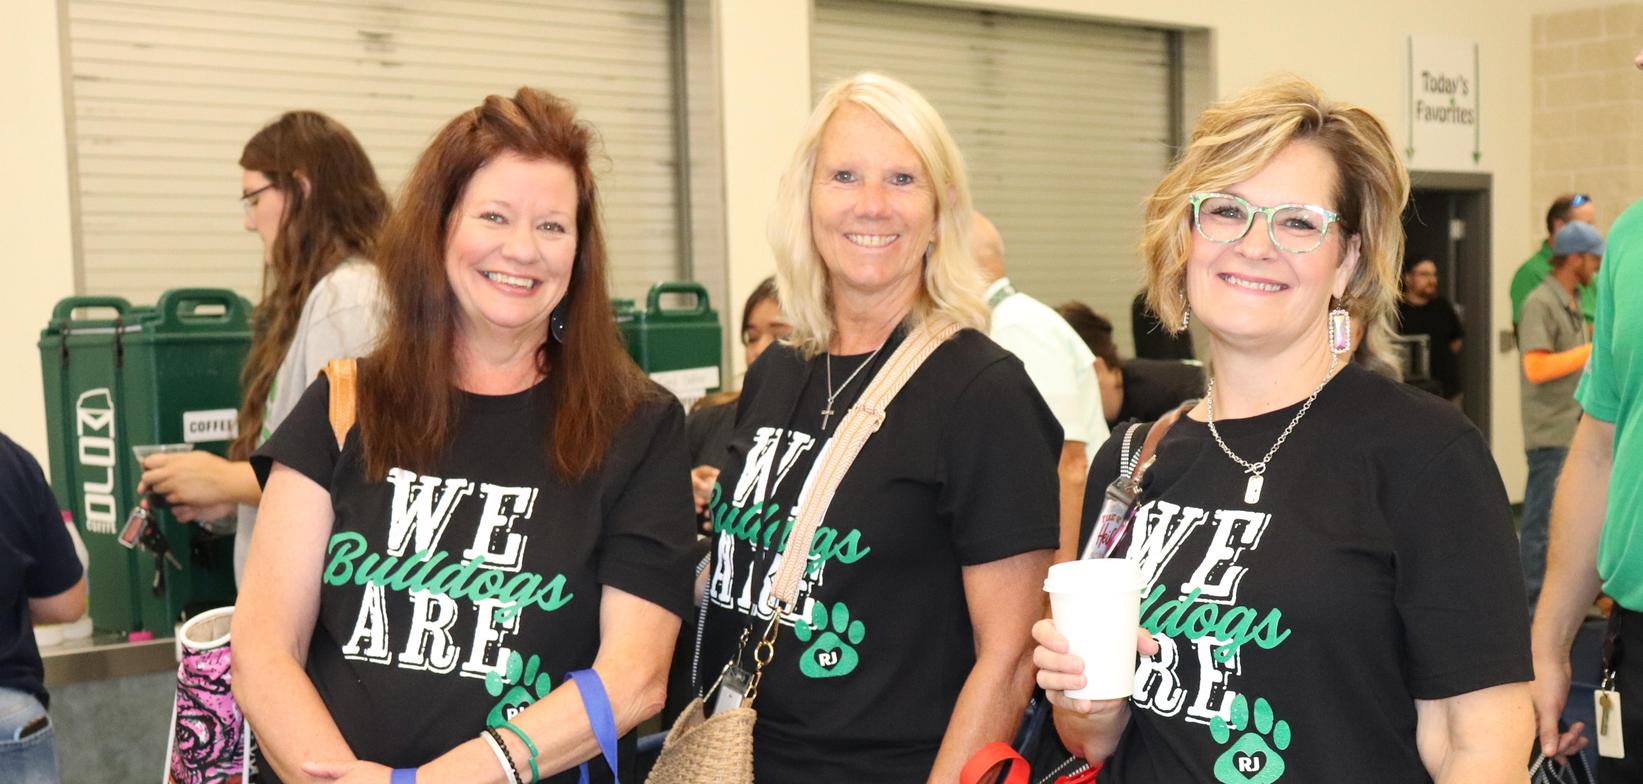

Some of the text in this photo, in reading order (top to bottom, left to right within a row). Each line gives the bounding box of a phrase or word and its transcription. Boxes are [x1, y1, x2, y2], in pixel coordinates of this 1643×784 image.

[1416, 99, 1475, 125] Favorites
[1421, 70, 1470, 97] Today's
[387, 467, 539, 573] WE
[709, 482, 871, 574] ulldgs
[1126, 500, 1272, 606] WE
[323, 531, 574, 624] Bulldogs
[1139, 584, 1291, 663] ldogs
[342, 580, 523, 684] ARE
[819, 651, 838, 667] RJ
[1130, 632, 1241, 730] RE
[1238, 756, 1260, 773] RJ
